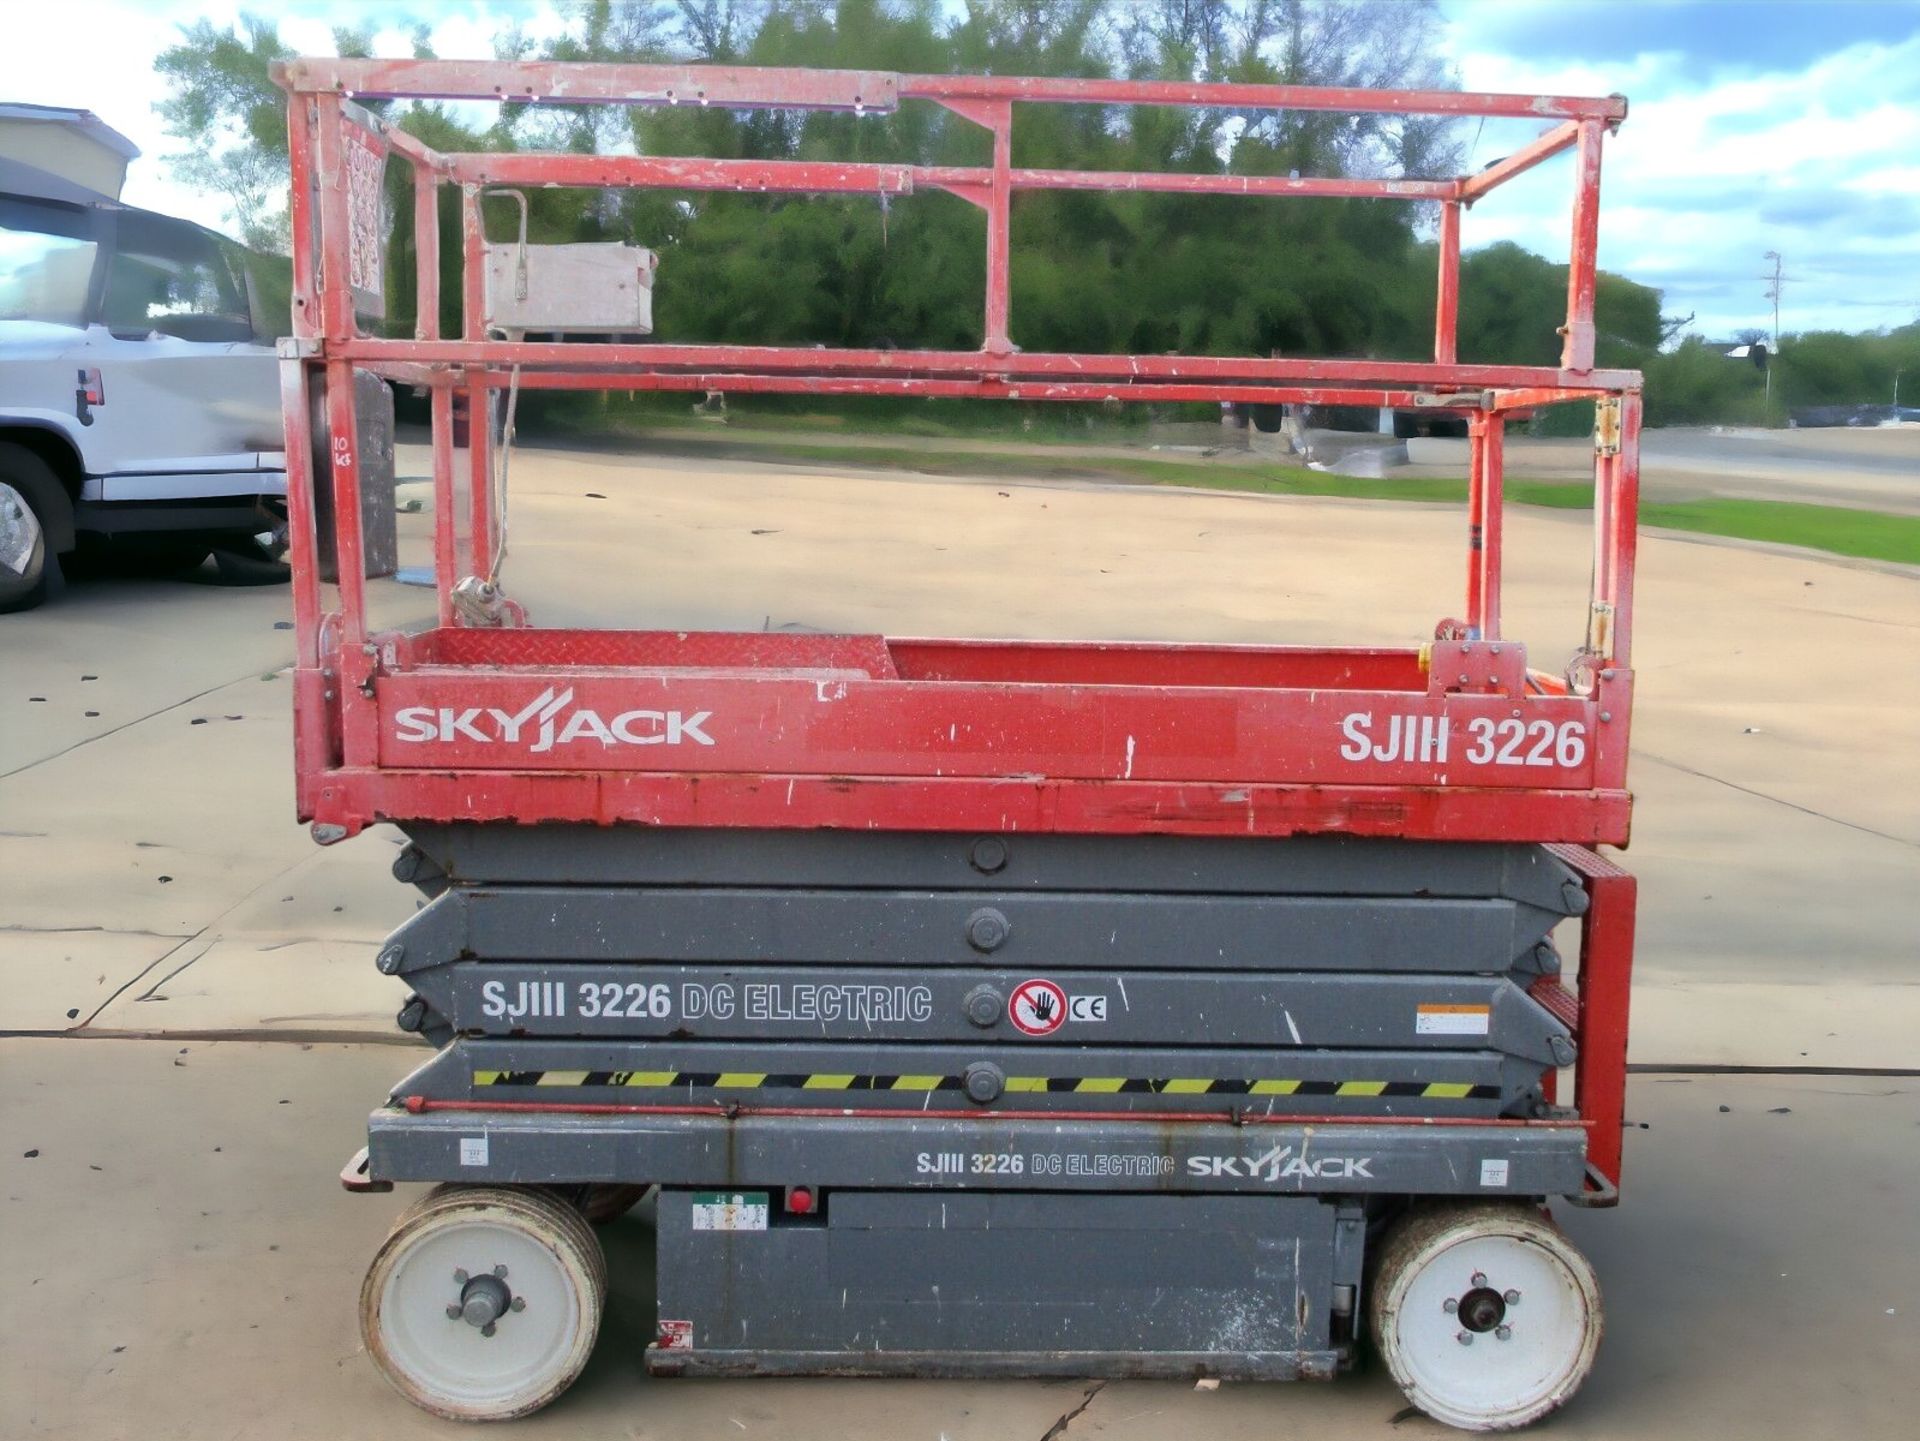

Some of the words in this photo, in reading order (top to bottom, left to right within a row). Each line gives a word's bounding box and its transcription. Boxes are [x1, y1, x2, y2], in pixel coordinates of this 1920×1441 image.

[395, 686, 715, 752] SKYJACK
[1340, 711, 1449, 763] SJIII
[1466, 717, 1585, 768] 3226
[482, 980, 565, 1017] SJIII
[578, 982, 671, 1018] 3226
[682, 983, 735, 1020] DC
[744, 984, 933, 1022] ELECTRIC
[1072, 997, 1104, 1019] CE
[916, 1152, 964, 1174] SJIII
[970, 1153, 1024, 1174] 3226
[1031, 1153, 1062, 1175] DC
[1065, 1154, 1175, 1176] ELECTRIC
[1187, 1145, 1375, 1182] SKYJACK
